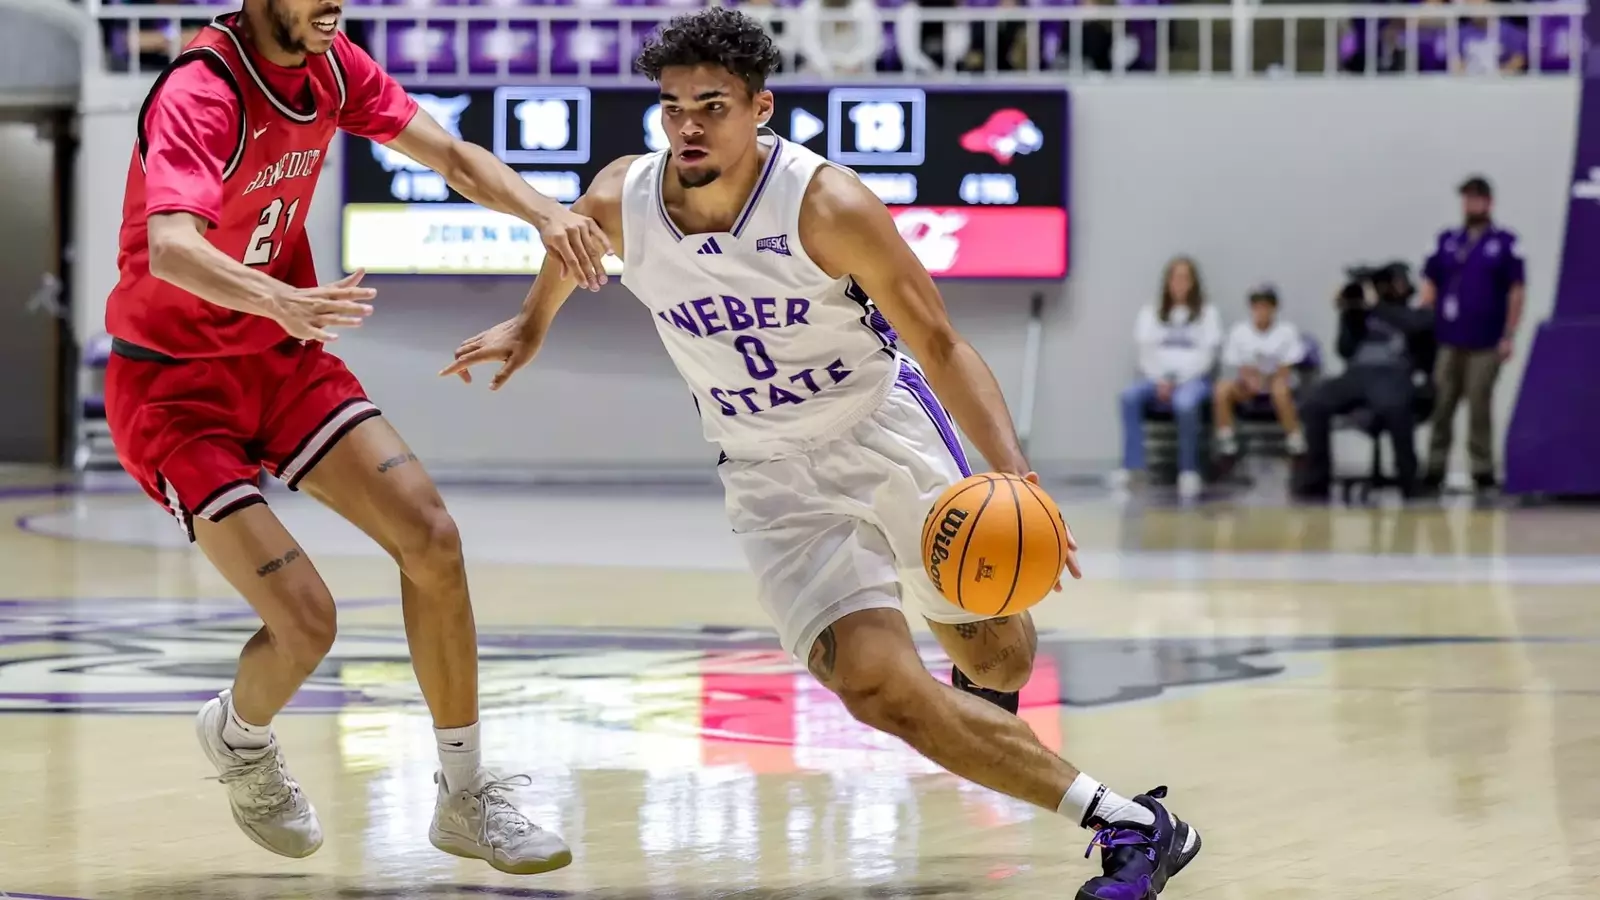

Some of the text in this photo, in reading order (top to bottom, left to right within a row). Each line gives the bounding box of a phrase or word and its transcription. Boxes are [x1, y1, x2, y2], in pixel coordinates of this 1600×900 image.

[242, 150, 321, 196] BENEDICT
[243, 198, 300, 266] 21
[658, 295, 811, 338] WEBER
[734, 335, 778, 381] 0
[710, 358, 854, 416] STATE
[929, 507, 970, 593] Wilson
